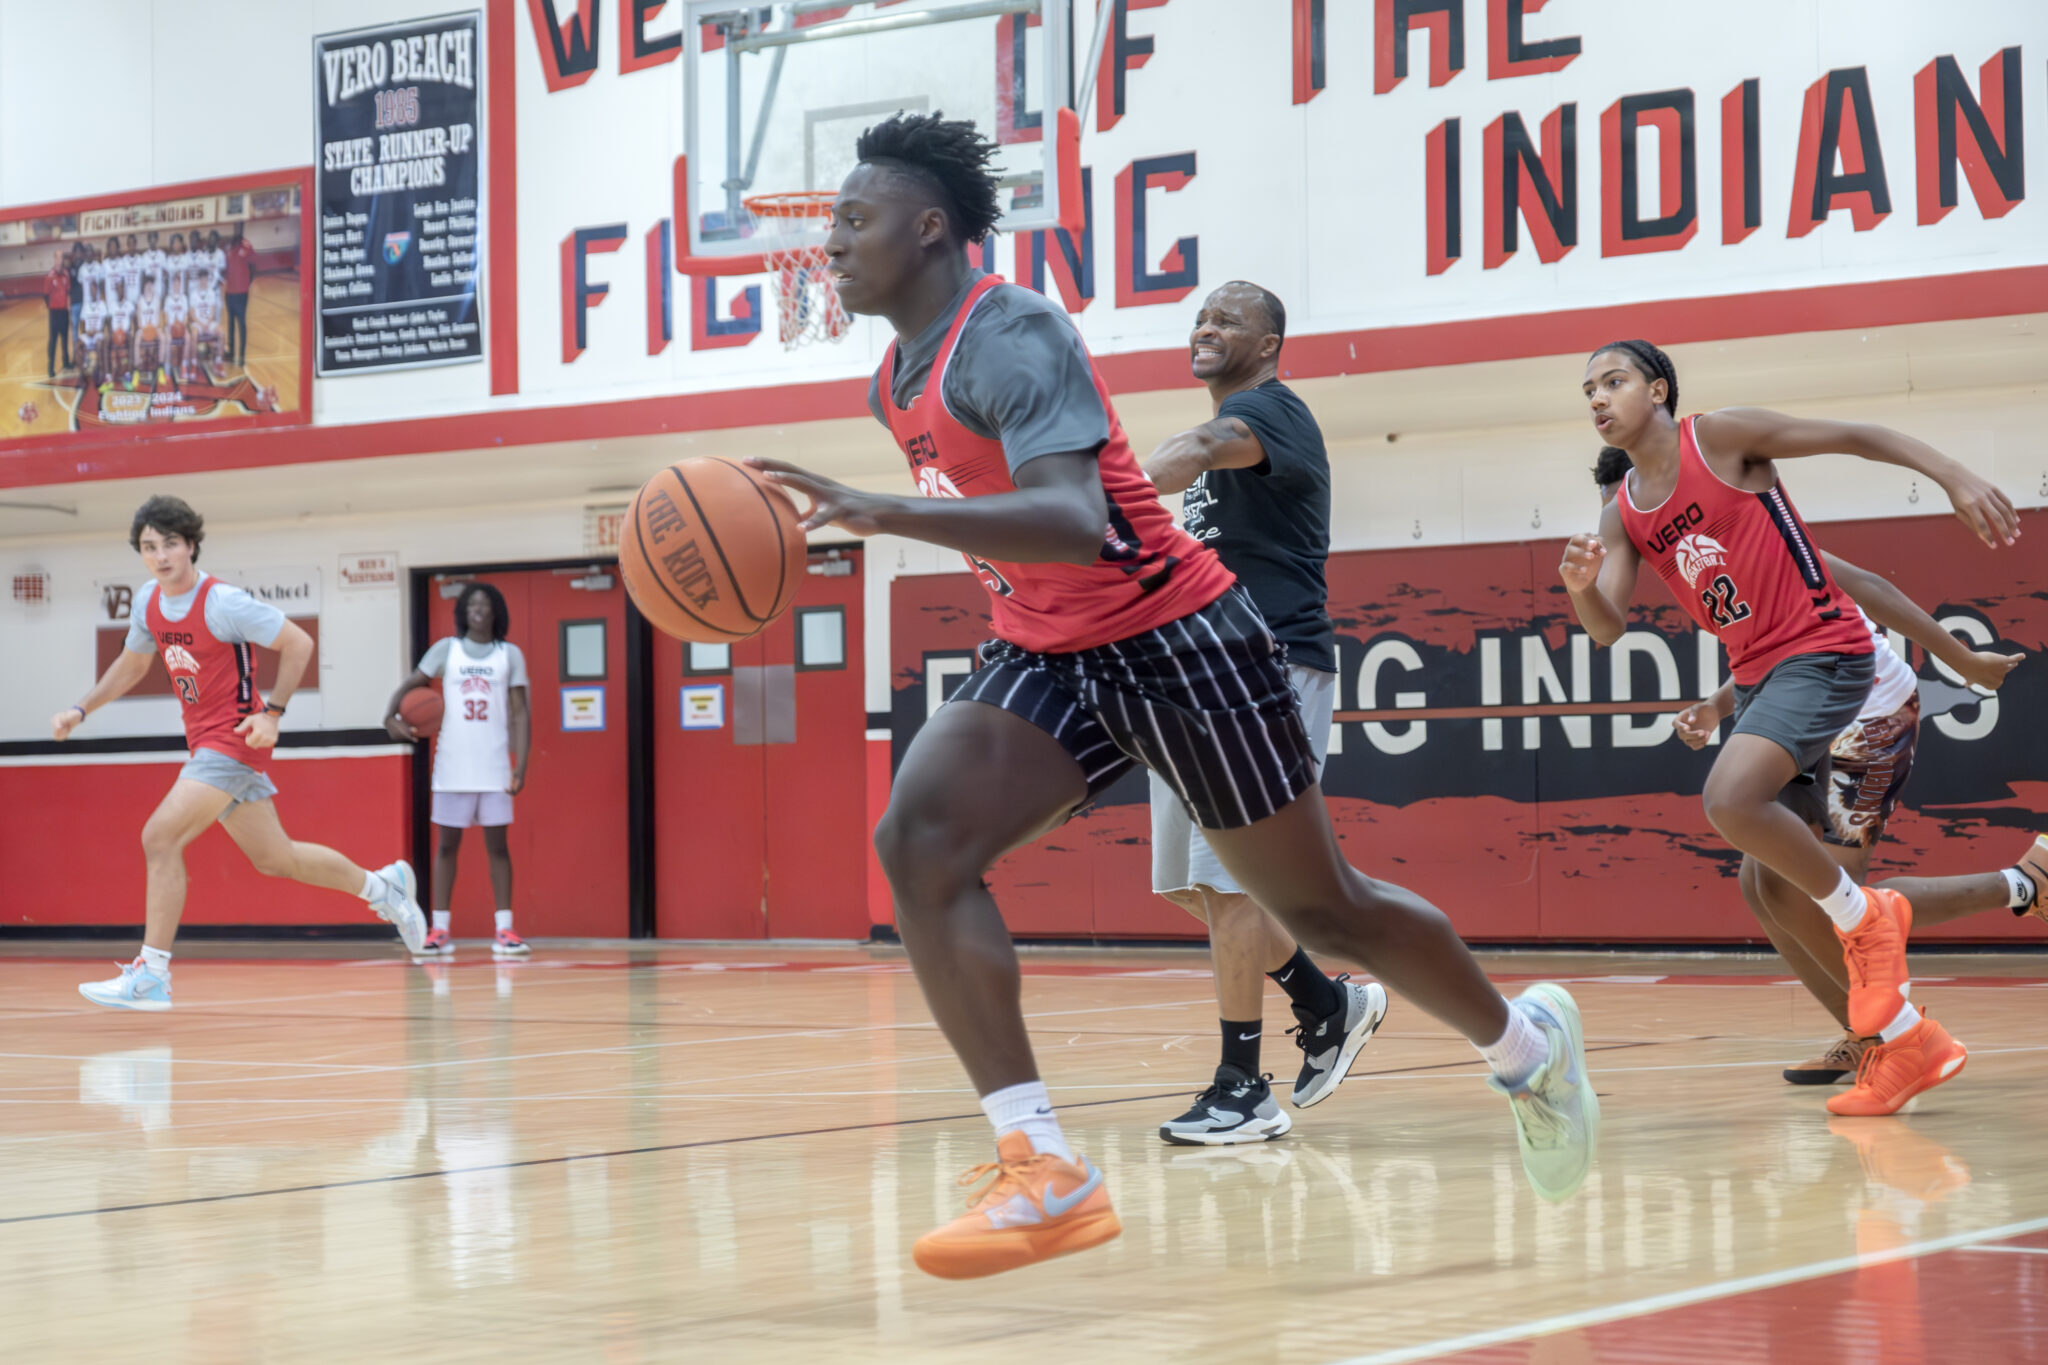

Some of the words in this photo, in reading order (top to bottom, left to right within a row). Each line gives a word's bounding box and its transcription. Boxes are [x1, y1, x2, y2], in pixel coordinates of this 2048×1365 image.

[323, 41, 387, 107] VERO
[391, 28, 474, 90] BEACH
[375, 86, 420, 129] 1985
[324, 137, 374, 171] STATE
[379, 123, 474, 163] RUNNER-UP
[1425, 44, 2048, 277] INDIAN
[351, 157, 446, 196] CHAMPIONS
[155, 204, 204, 224] INDIANS
[150, 404, 196, 417] Indians
[151, 391, 182, 403] 2024
[646, 489, 687, 545] THE
[1647, 502, 1704, 554] VERO
[260, 583, 311, 601] School
[661, 538, 721, 610] ROCK
[1702, 573, 1752, 629] 22
[158, 630, 194, 647] VERO
[175, 676, 199, 704] 21
[459, 665, 494, 676] VERO
[464, 700, 489, 721] 32
